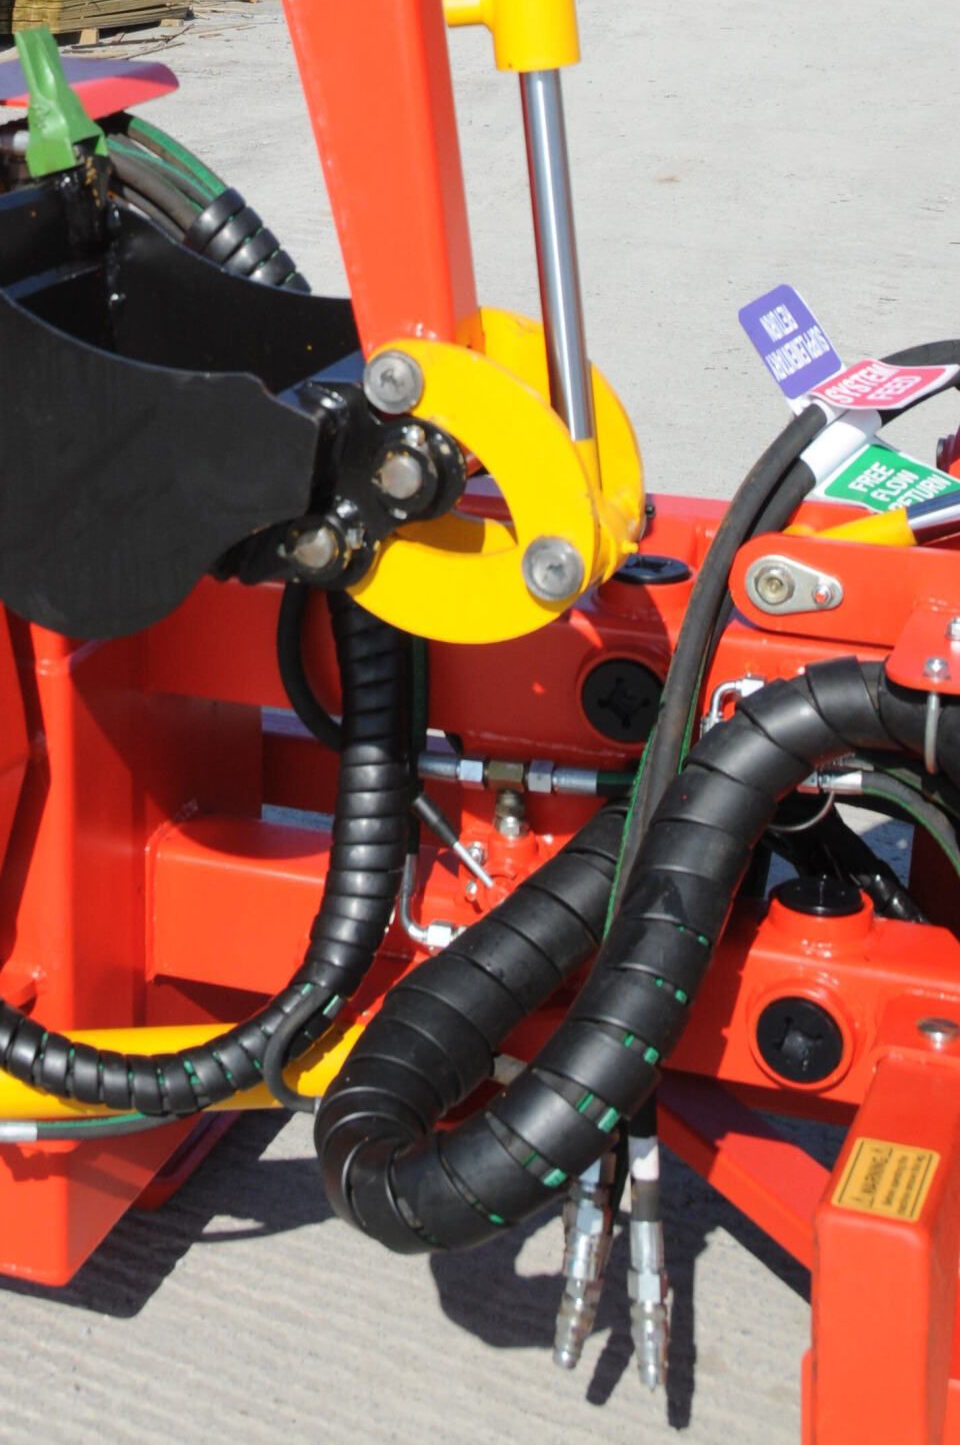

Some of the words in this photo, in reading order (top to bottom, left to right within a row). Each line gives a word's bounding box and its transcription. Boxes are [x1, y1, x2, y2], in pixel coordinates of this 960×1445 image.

[824, 363, 899, 404] SYSTEM
[867, 375, 922, 401] FEED
[848, 461, 894, 493] FREE
[870, 469, 920, 502] FLOW
